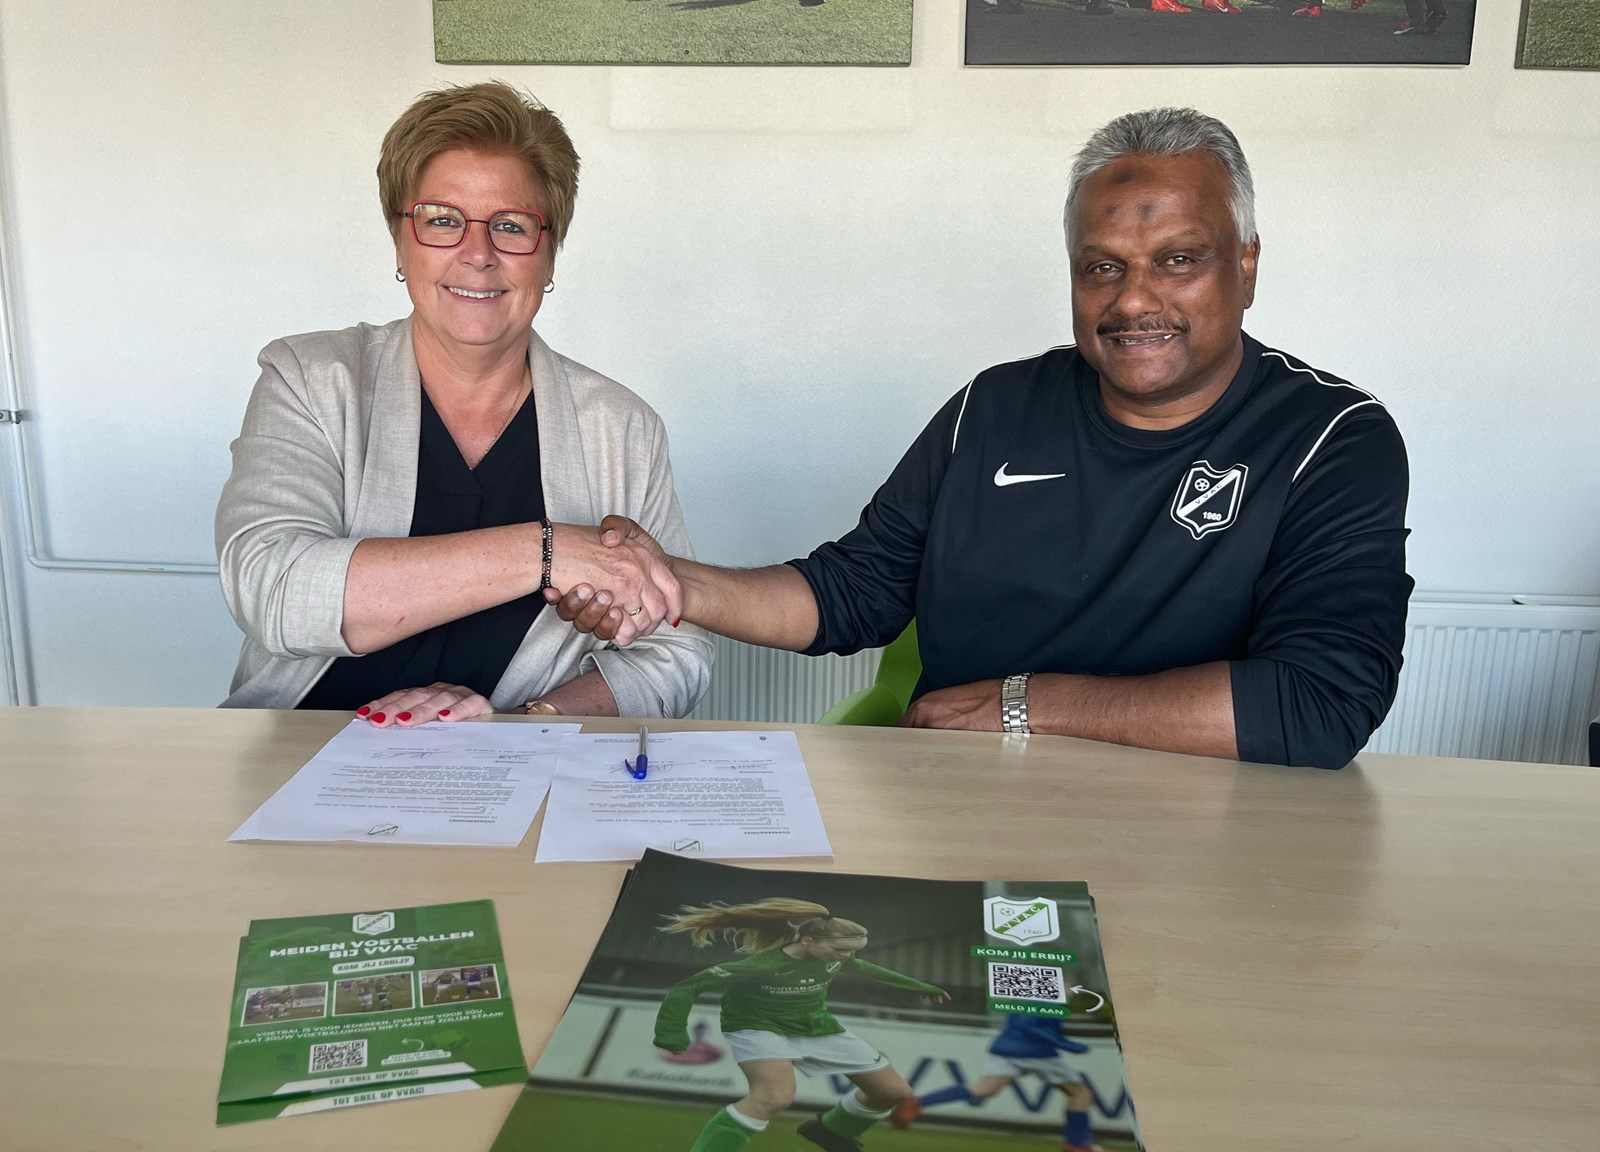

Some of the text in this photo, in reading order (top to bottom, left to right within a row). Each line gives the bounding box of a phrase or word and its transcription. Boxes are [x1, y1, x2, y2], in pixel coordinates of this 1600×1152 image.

[1195, 484, 1222, 504] VVAC
[1203, 511, 1222, 521] 1960
[1003, 906, 1040, 929] VVAC
[270, 930, 474, 957] MEIDEN VOETBALLEN
[329, 943, 419, 959] BIJ VVAC
[976, 948, 1072, 962] KOM JIJ ERBIJ?
[338, 964, 359, 972] KOM
[471, 1011, 504, 1020] STAAN!
[994, 1003, 1025, 1011] MELD
[1040, 1006, 1064, 1016] AAN
[256, 1029, 298, 1037] VOETBAL
[349, 1075, 372, 1083] SNEL
[391, 1069, 419, 1077] VVAC!
[332, 1086, 425, 1106] TOT SNEL OP VVAC!
